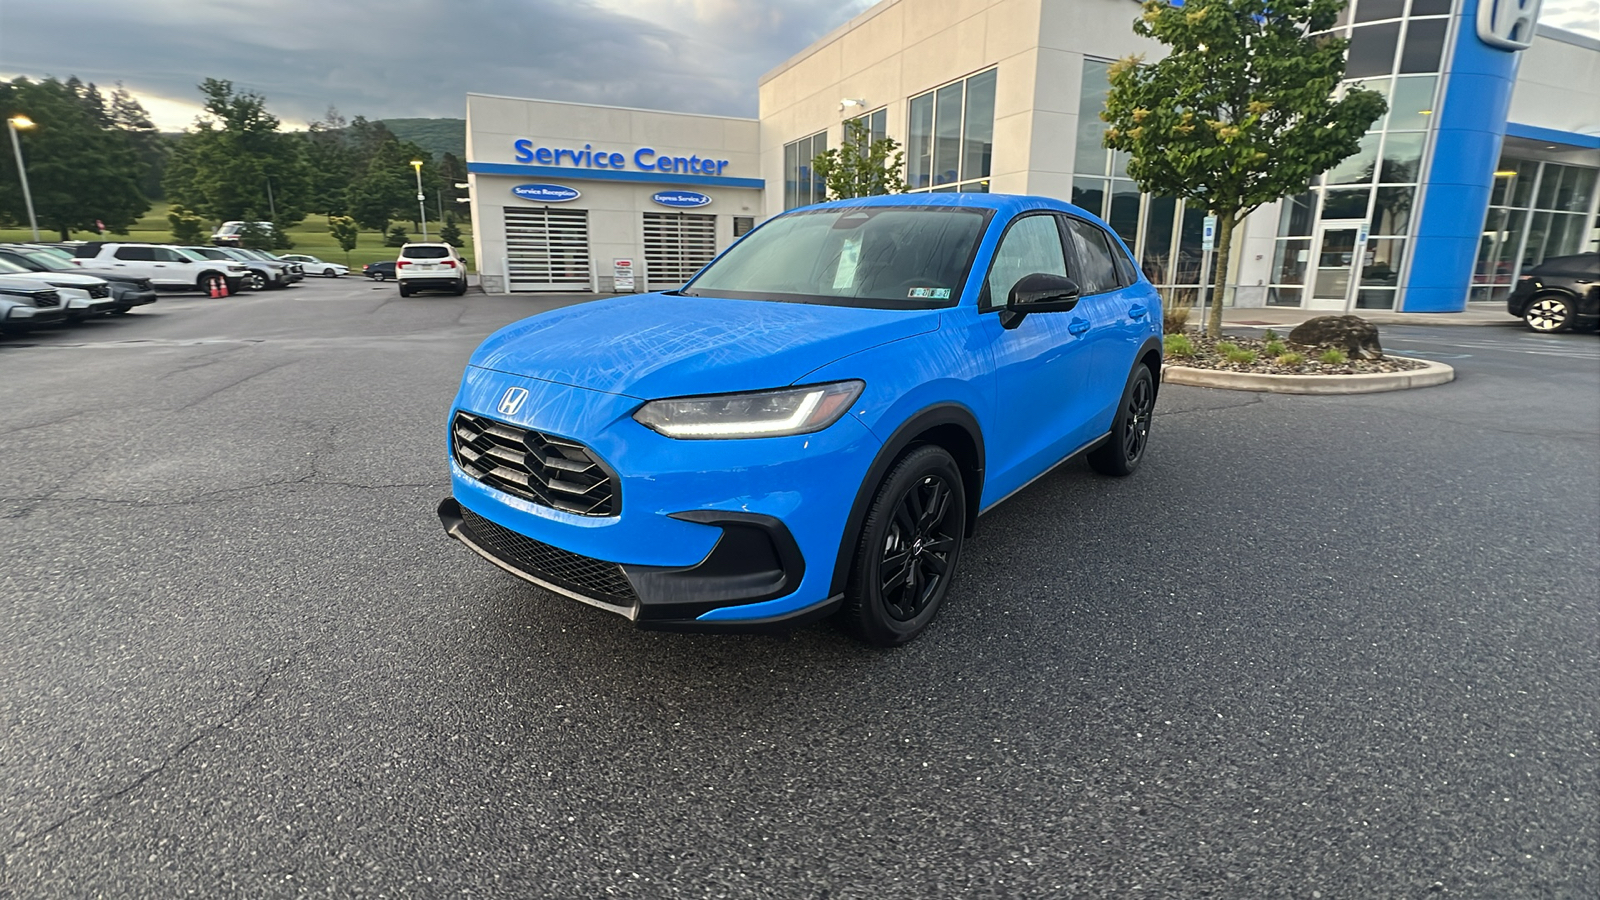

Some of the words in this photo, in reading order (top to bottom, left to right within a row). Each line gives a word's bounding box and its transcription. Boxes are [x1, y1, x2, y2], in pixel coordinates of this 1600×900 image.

[514, 138, 625, 169] Service
[633, 148, 729, 175] Center
[542, 188, 577, 197] Reception
[654, 194, 678, 203] Express
[678, 195, 700, 203] Service
